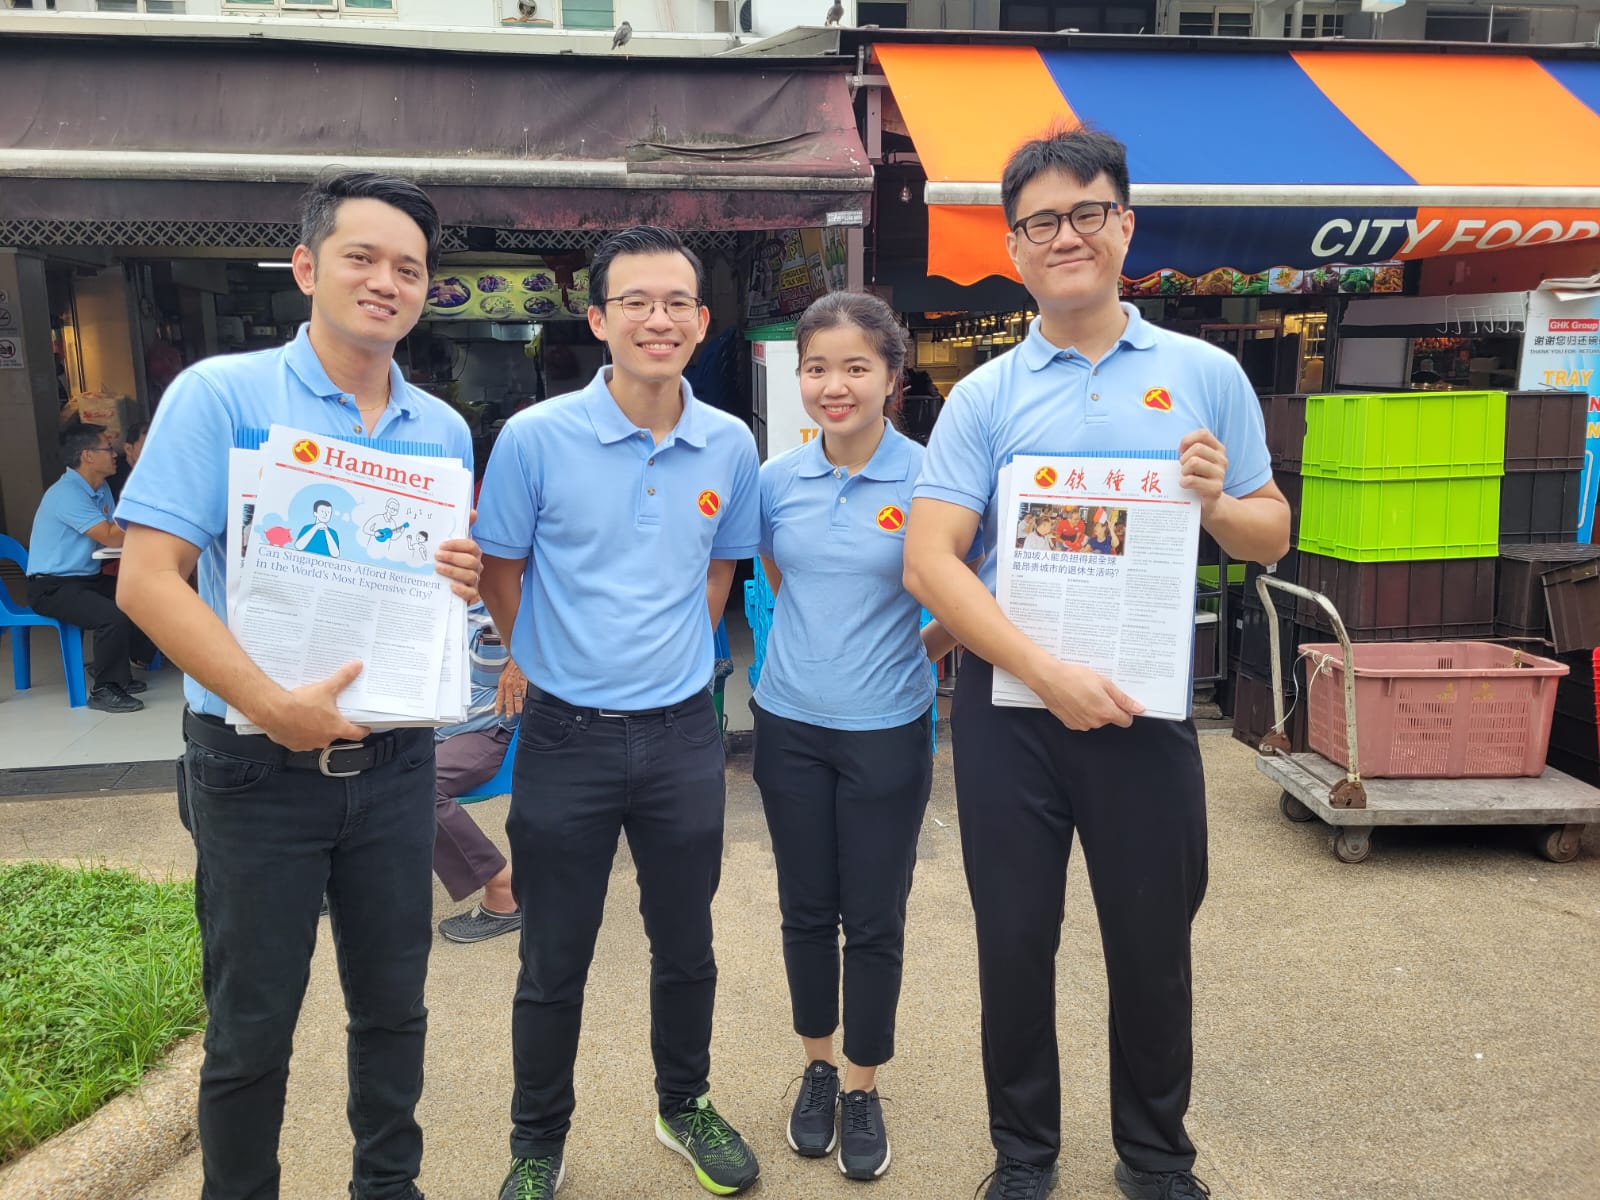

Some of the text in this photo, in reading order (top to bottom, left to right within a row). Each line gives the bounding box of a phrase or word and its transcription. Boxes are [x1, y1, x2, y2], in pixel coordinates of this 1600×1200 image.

[1310, 218, 1600, 257] CITY FOOD
[1550, 321, 1598, 331] GHK Group
[1534, 336, 1600, 346] 谢谢您归还碗
[1543, 369, 1593, 386] TRAY
[323, 446, 435, 491] Hammer
[258, 546, 441, 590] Can Singaporeans Afford Retirement
[1013, 550, 1118, 566] 新加坡人能负担得起全球
[256, 557, 268, 569] in
[270, 559, 290, 573] the
[332, 571, 356, 585] Most
[359, 576, 407, 596] Expensive
[408, 588, 433, 600] City?
